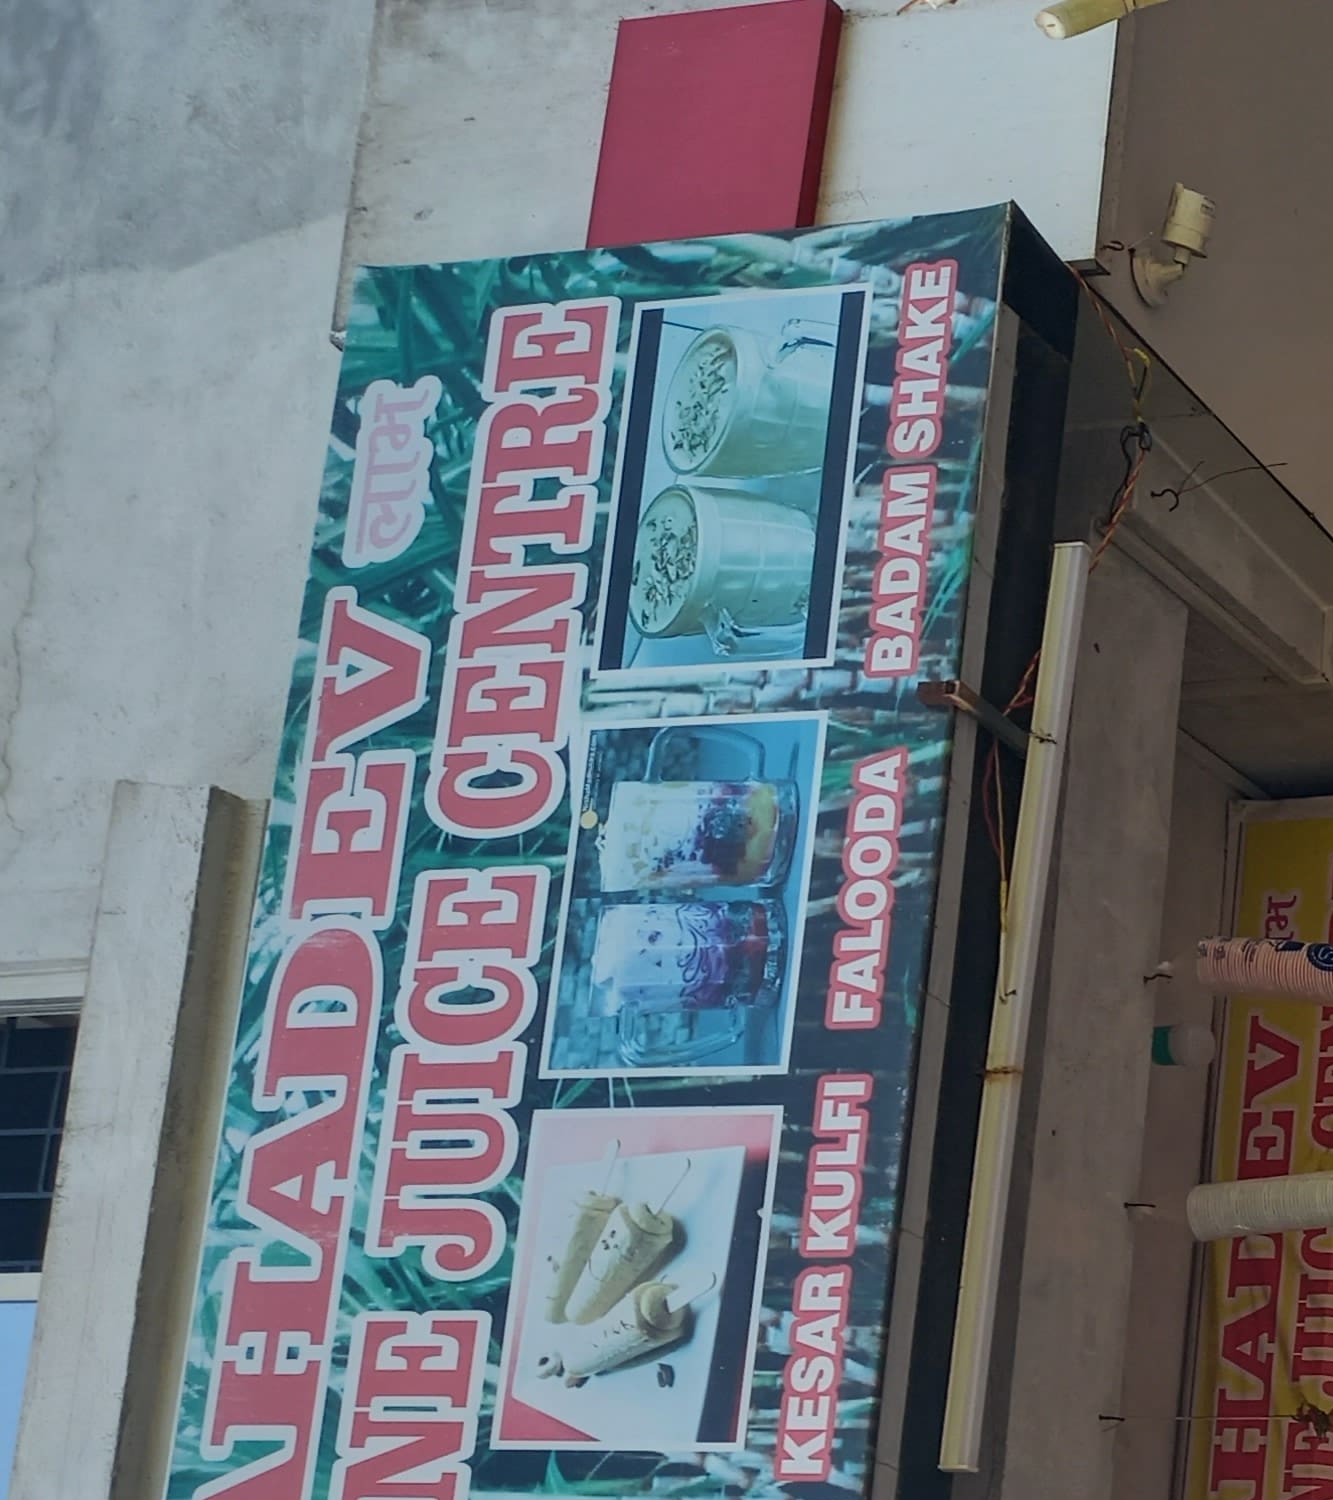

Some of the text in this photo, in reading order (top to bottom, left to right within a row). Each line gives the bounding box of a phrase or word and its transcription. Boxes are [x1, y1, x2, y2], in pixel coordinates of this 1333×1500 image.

[436, 305, 611, 830] CENTRE
[871, 266, 952, 671] BADAM SHAKE
[378, 873, 538, 1272] JUICE
[832, 753, 904, 1023] FALOODA
[778, 1078, 868, 1476] KESAR KULFI
